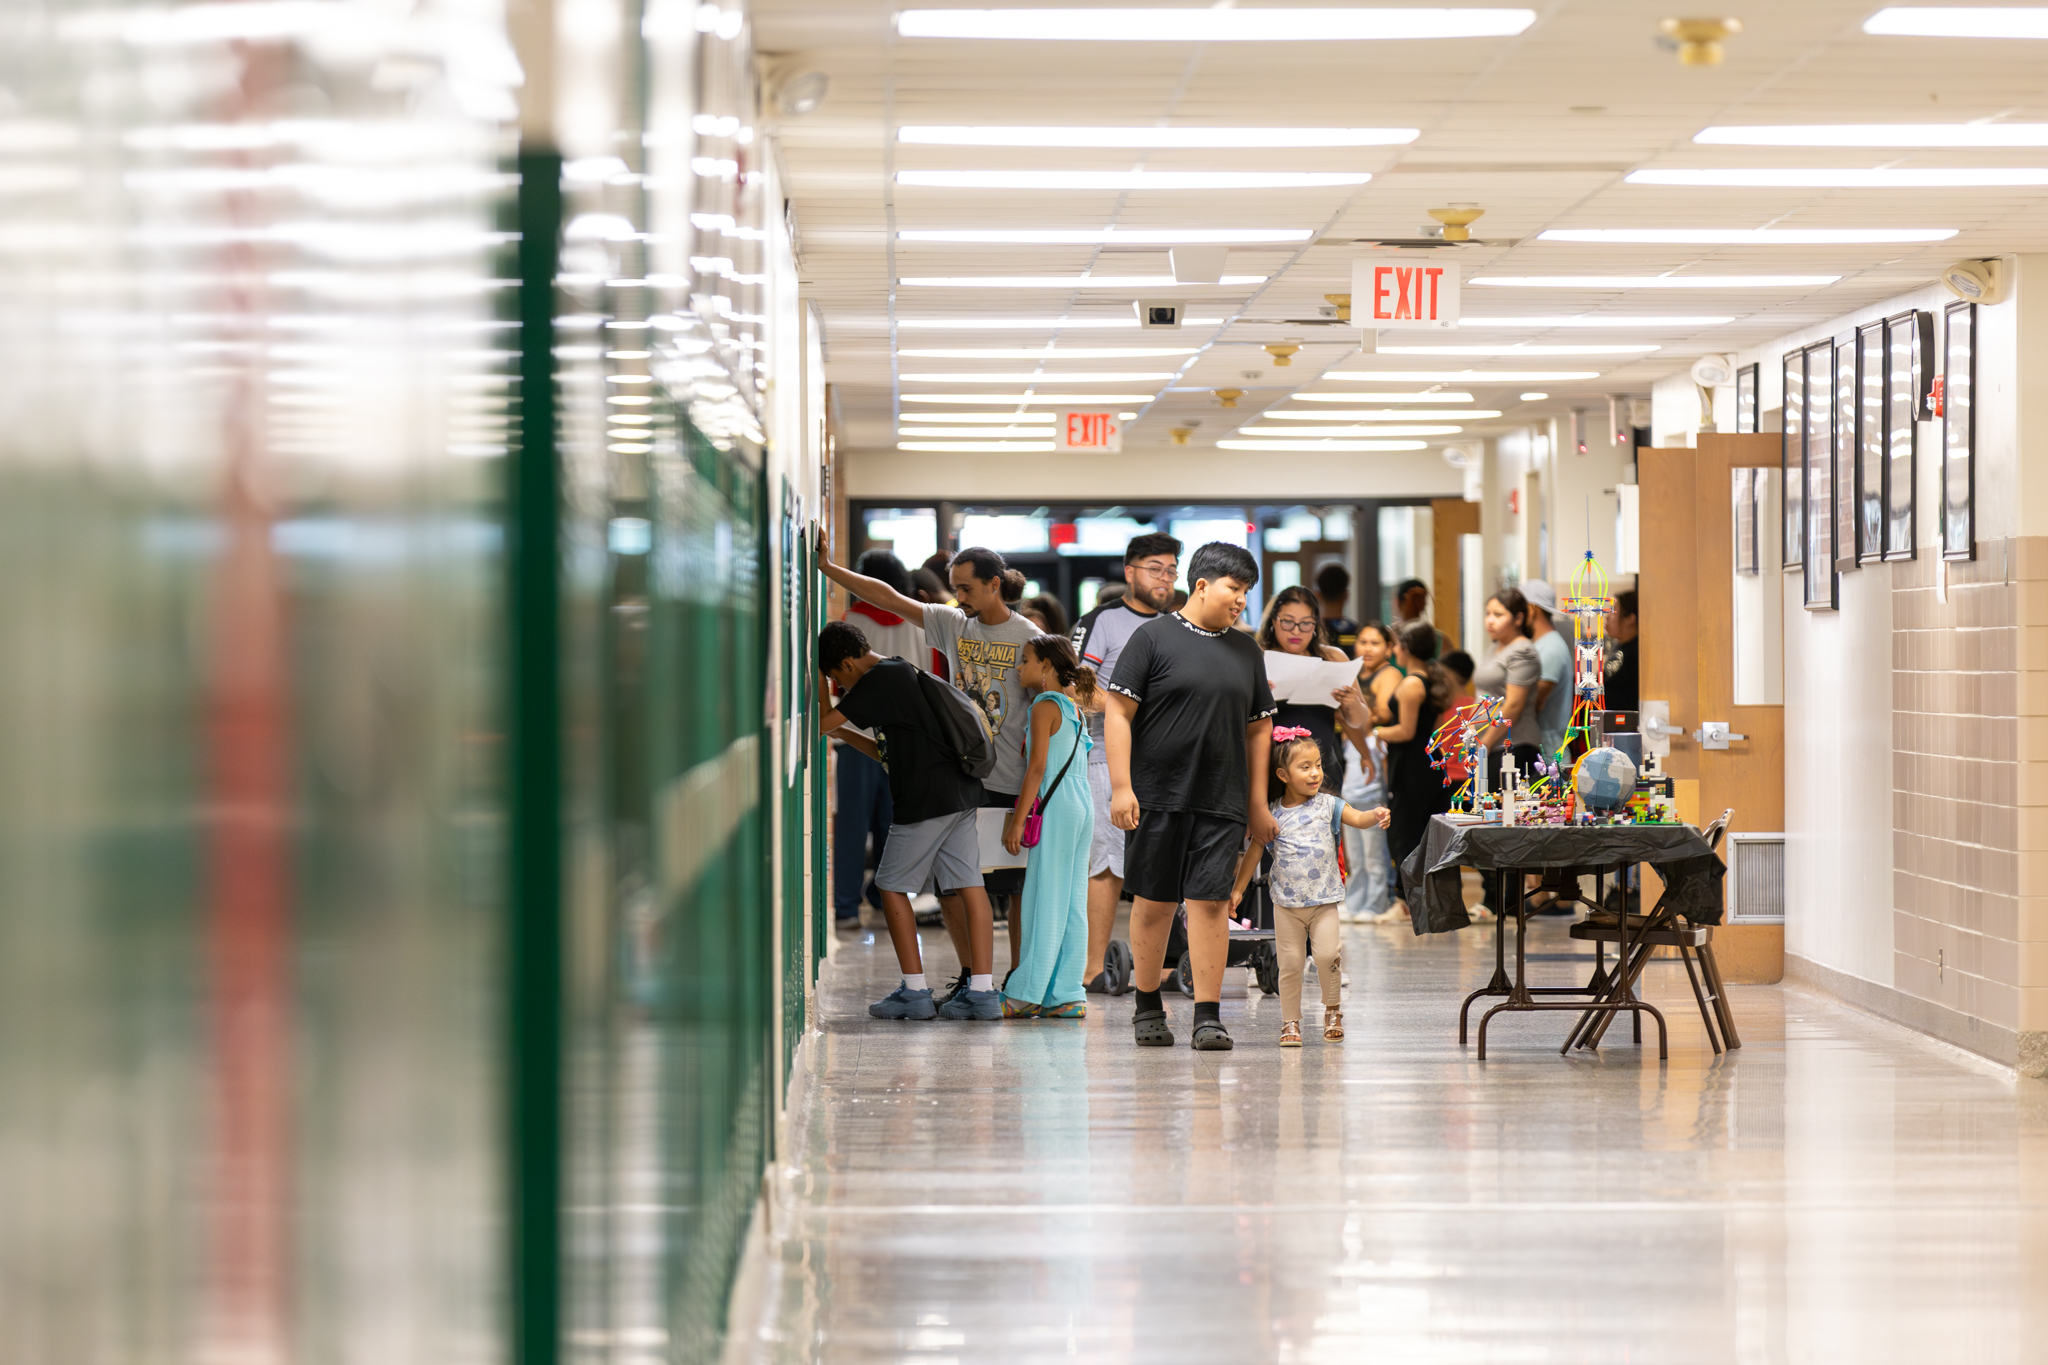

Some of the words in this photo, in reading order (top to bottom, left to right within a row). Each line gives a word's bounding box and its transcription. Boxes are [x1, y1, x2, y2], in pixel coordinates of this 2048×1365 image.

[1374, 266, 1444, 320] EXIT
[1440, 320, 1449, 328] 46
[1067, 412, 1112, 446] EXIT
[1072, 626, 1087, 656] ULLS
